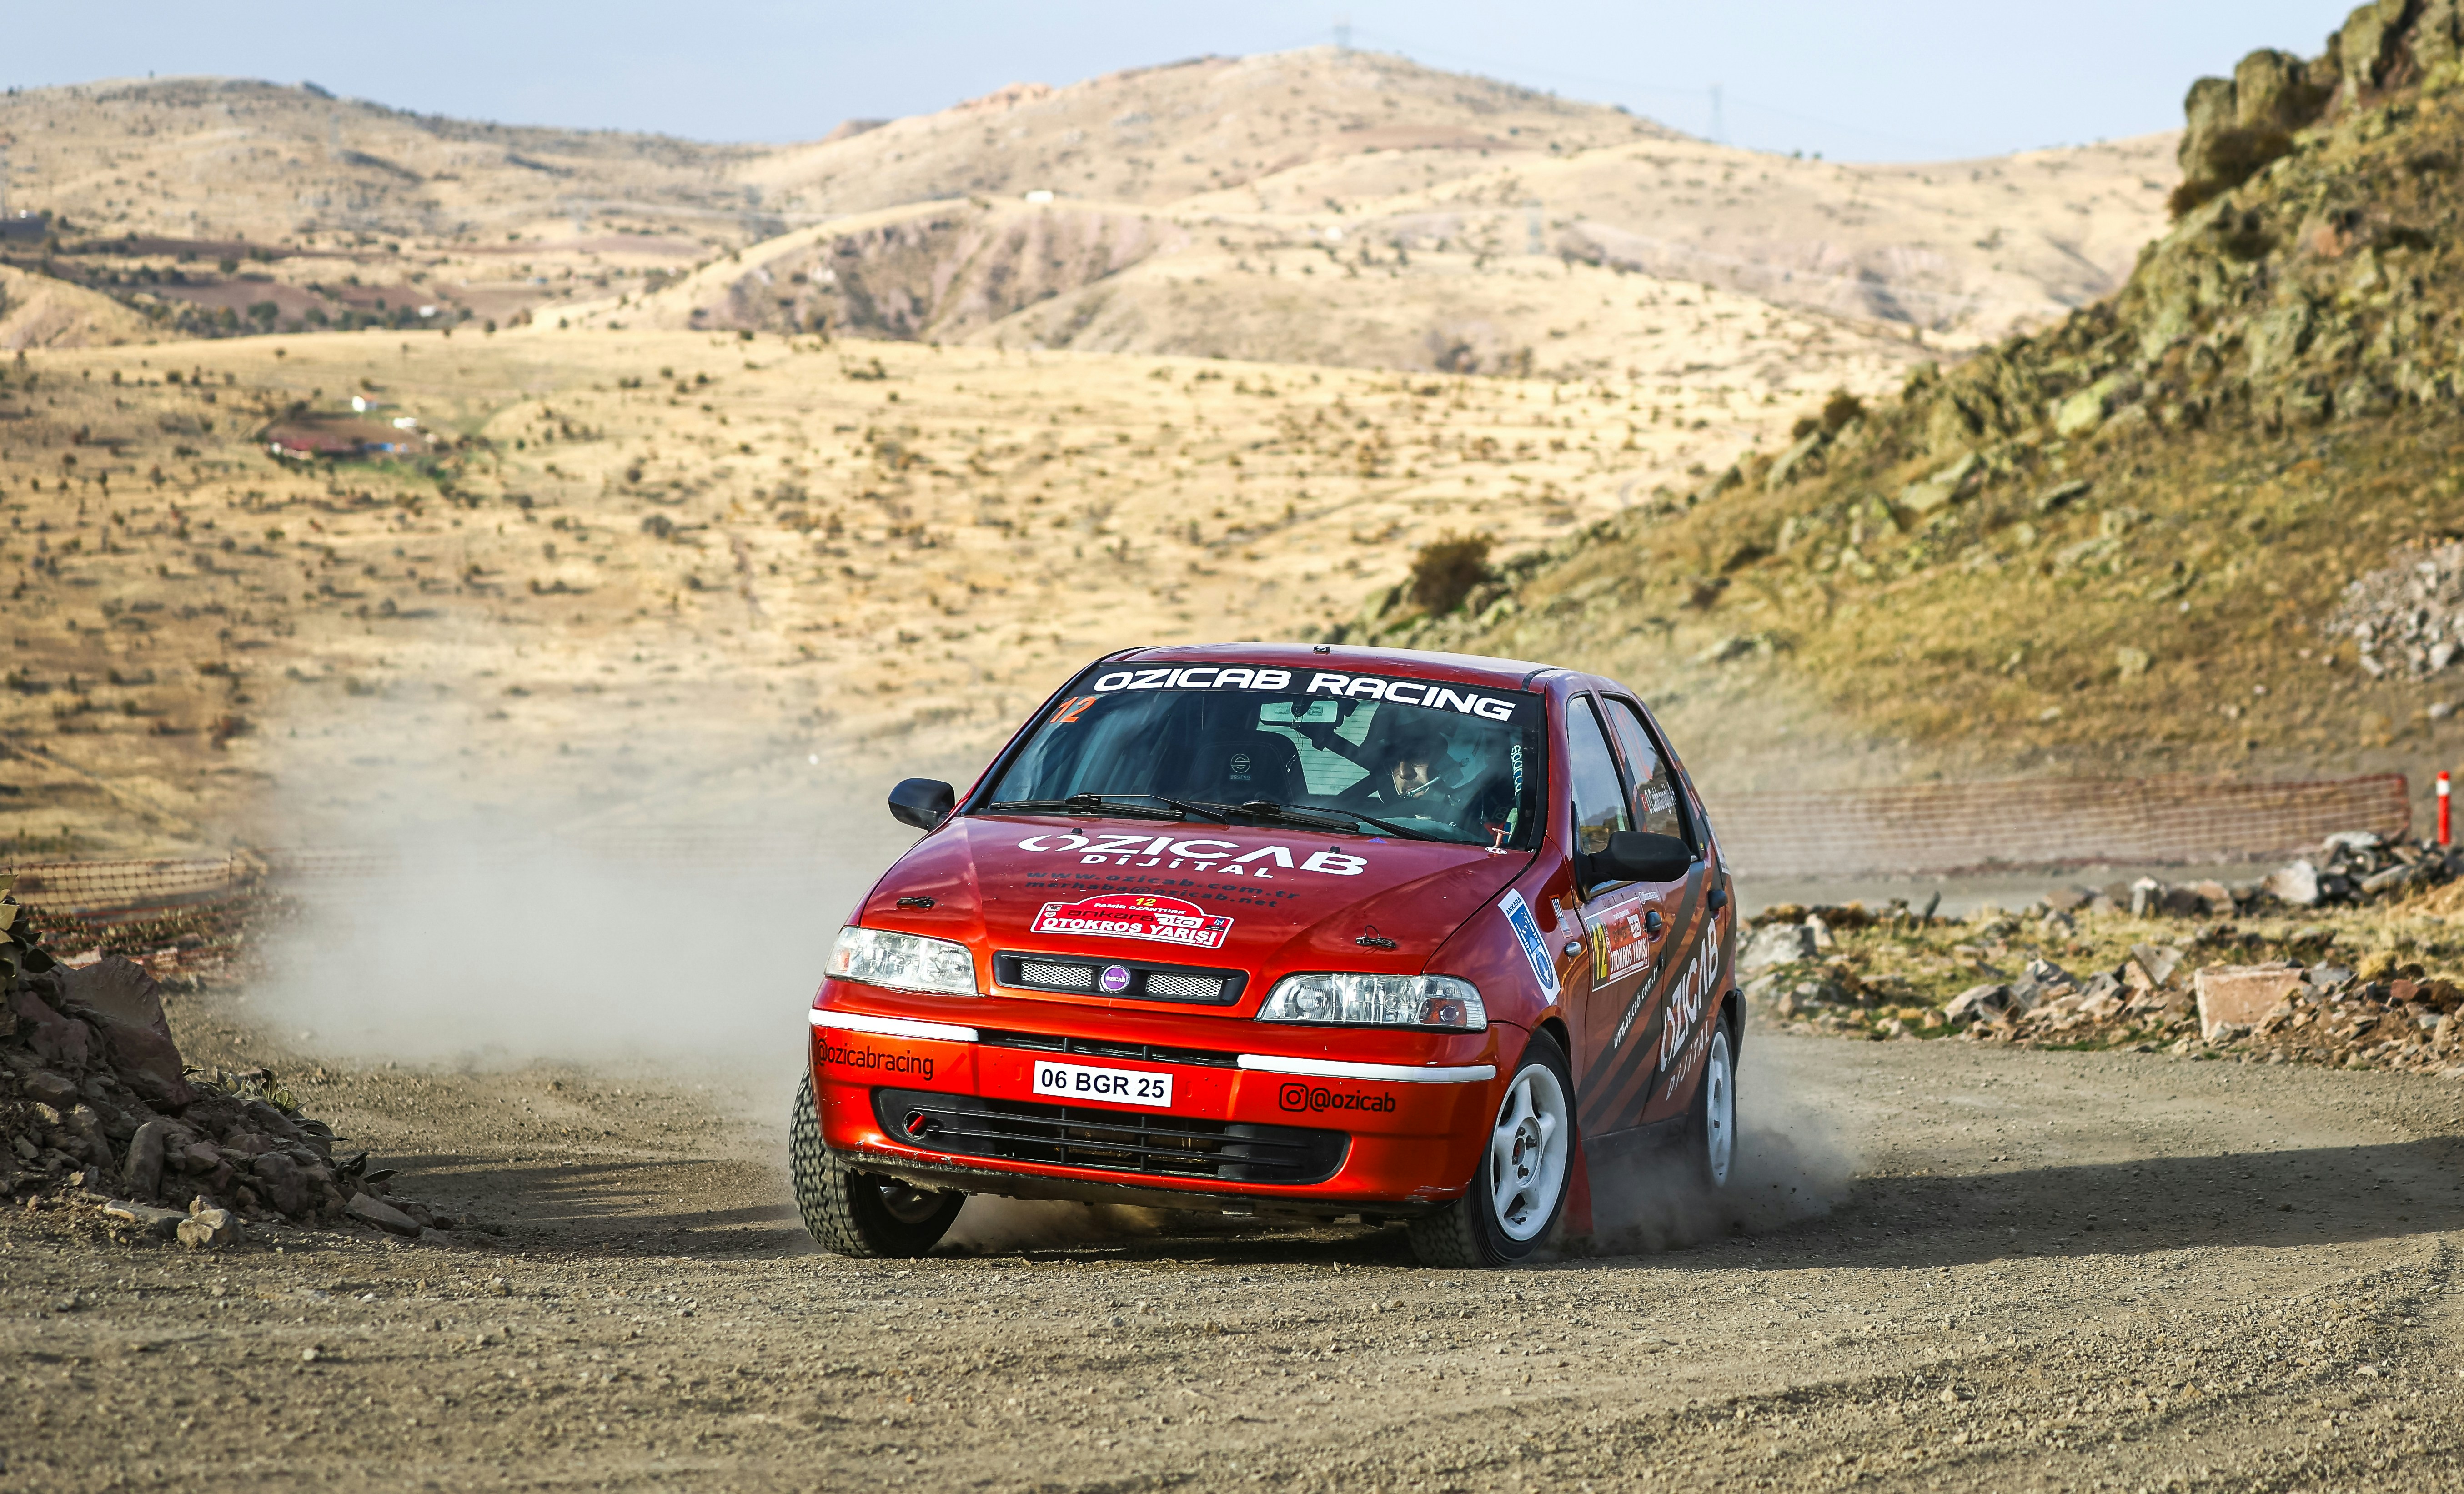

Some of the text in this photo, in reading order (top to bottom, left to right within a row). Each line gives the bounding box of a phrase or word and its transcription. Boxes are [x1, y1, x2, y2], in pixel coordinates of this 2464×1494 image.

[1093, 667, 1516, 722] OZICAB RACING
[1049, 697, 1096, 723] 12
[1018, 834, 1368, 876] OZICAB
[1025, 882, 1278, 907] merhaba@ozicab.net
[1026, 872, 1300, 899] www.ozicab.com.tr
[1129, 906, 1186, 915] OZANTÜRK
[1136, 897, 1156, 906] 12
[1506, 897, 1522, 916] ANKARA
[1042, 918, 1218, 943] OTOKROS YARIŞI
[1591, 922, 1607, 980] 12
[1610, 943, 1632, 973] OTOKROS
[1614, 965, 1658, 1049] www.ozicab.com.tr
[1660, 917, 1719, 1072] OZICAB
[818, 1038, 934, 1081] @ozicabracing
[1041, 1068, 1164, 1098] 06 BGR 25
[1309, 1087, 1396, 1113] @ozicab
